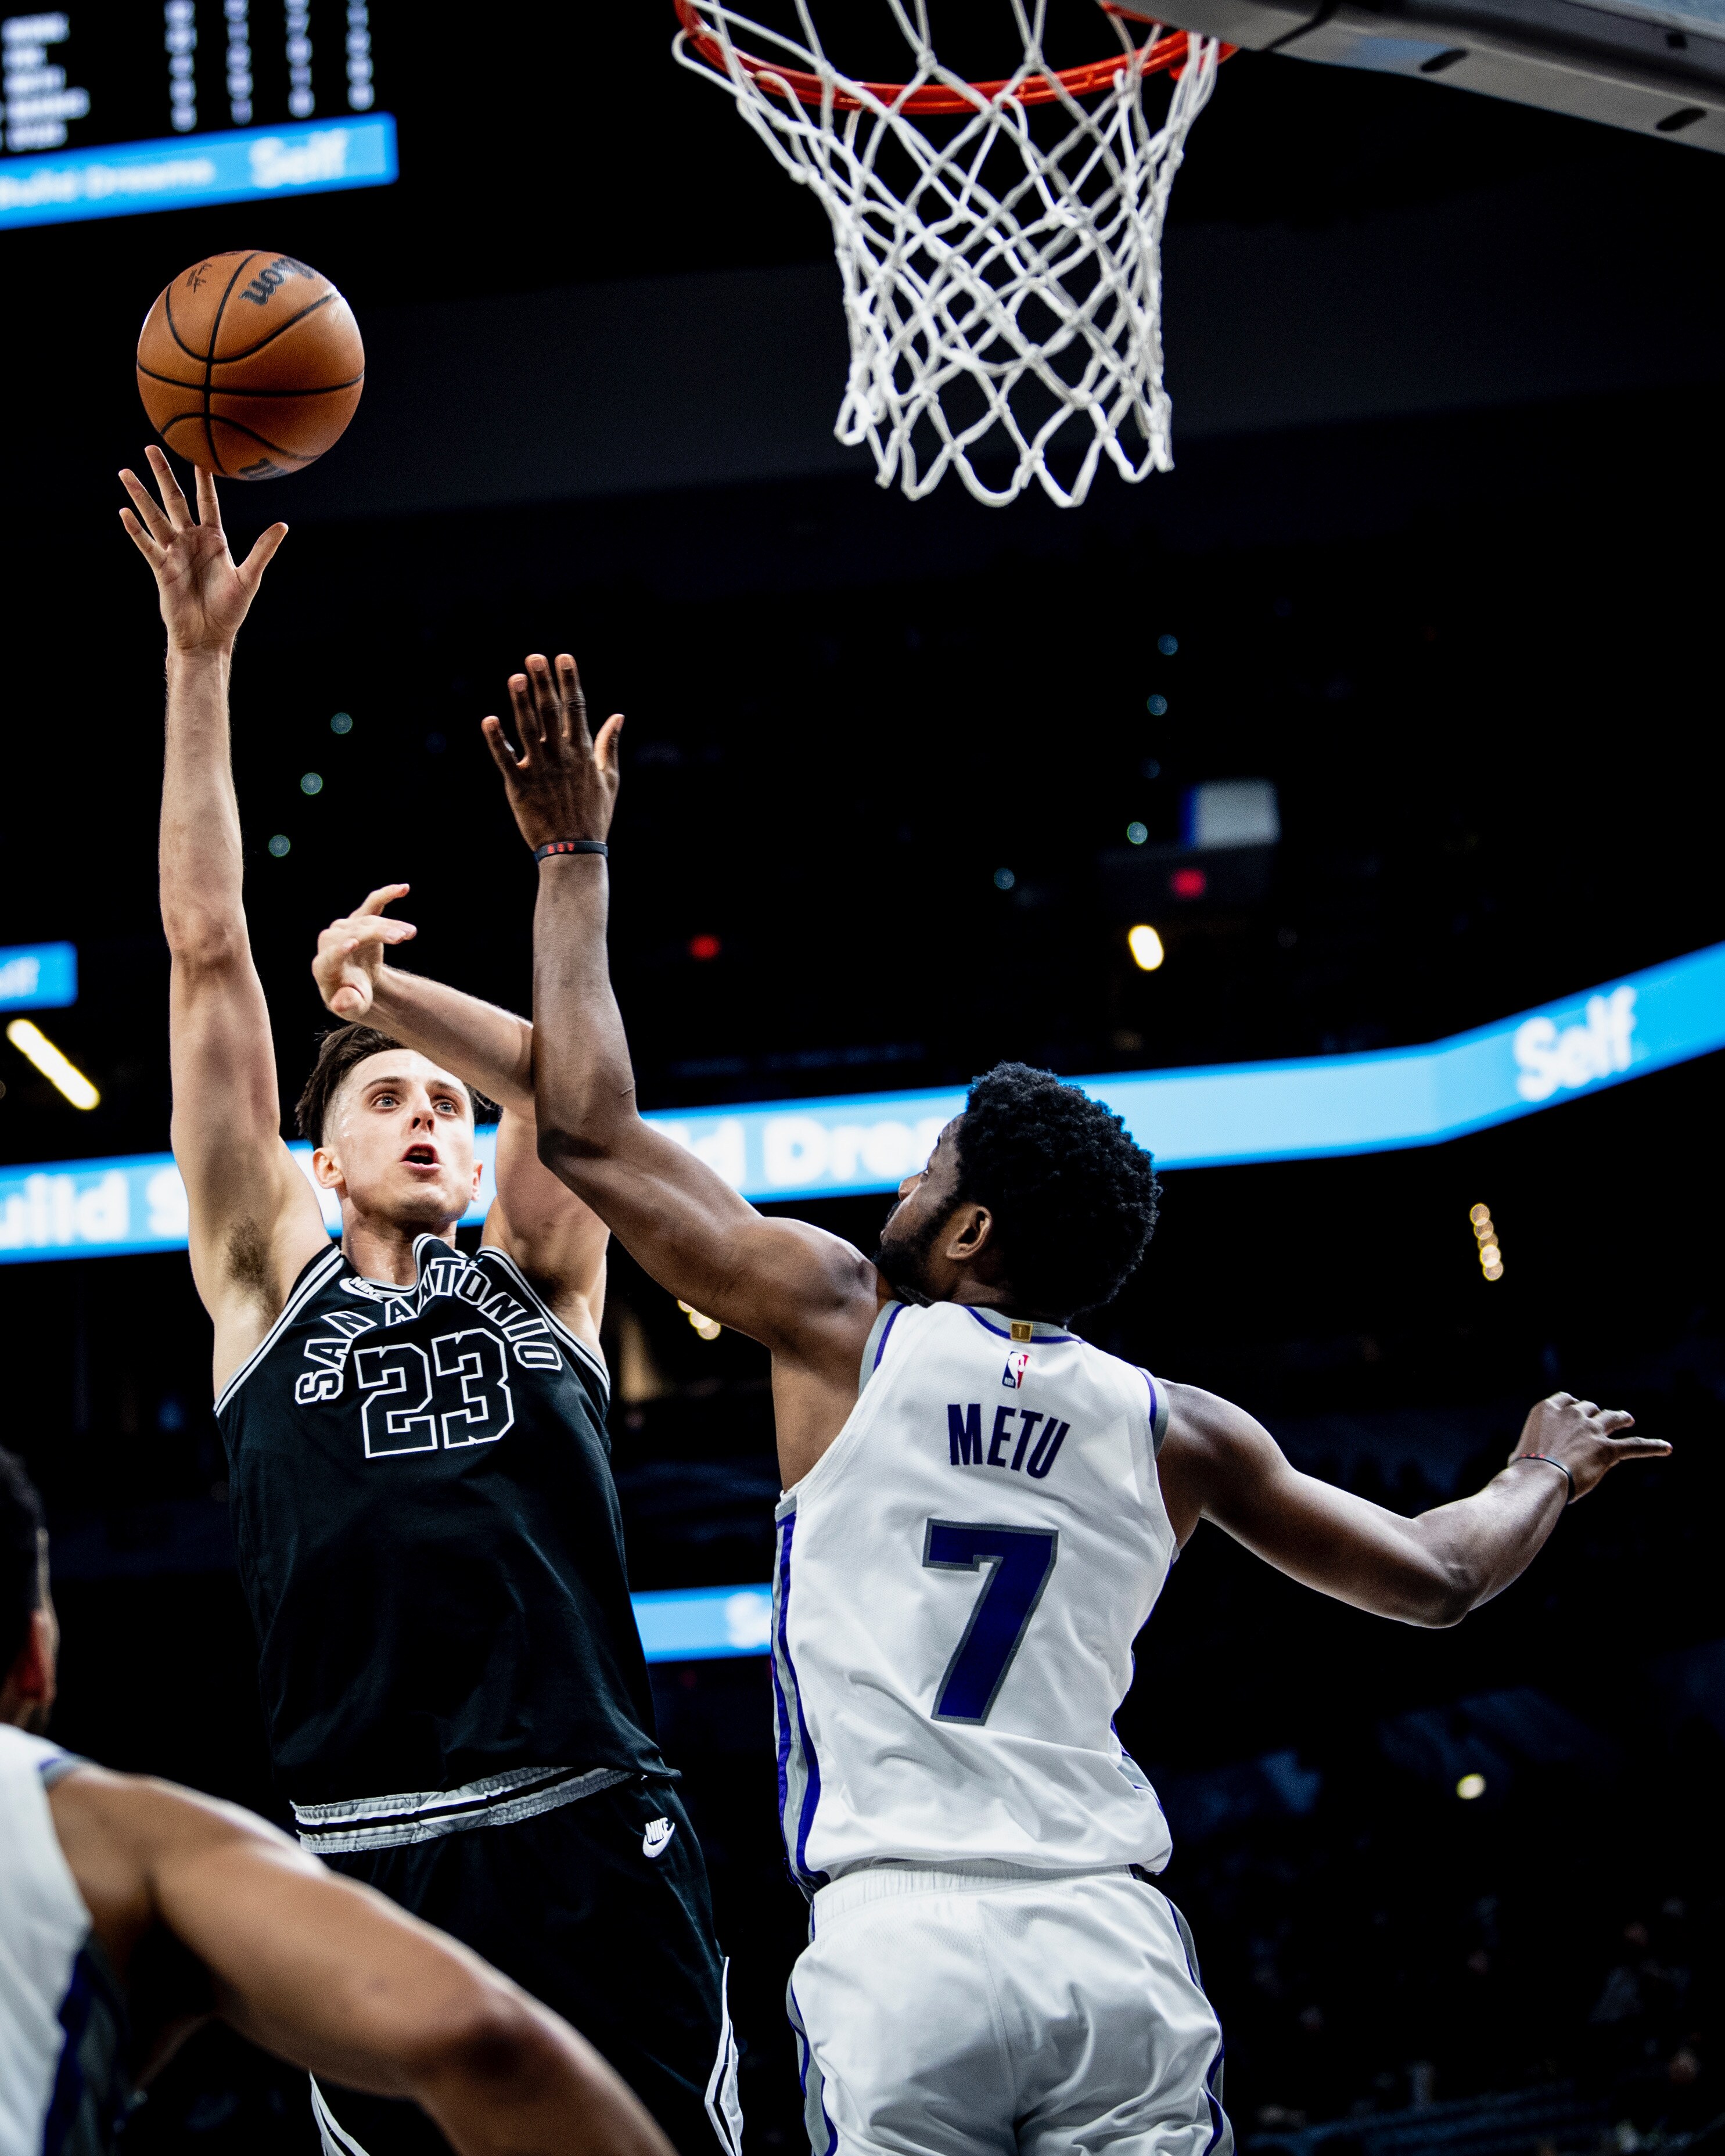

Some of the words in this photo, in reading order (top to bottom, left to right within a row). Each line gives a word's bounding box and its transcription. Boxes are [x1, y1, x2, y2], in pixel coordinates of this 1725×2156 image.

[1514, 984, 1637, 1102] Self
[295, 1310, 377, 1405] SAN
[384, 1257, 563, 1371] ANTONIO
[353, 1327, 515, 1458] 23
[947, 1403, 1071, 1479] METU
[922, 1517, 1059, 1726] 7
[645, 1817, 669, 1844] NIKE
